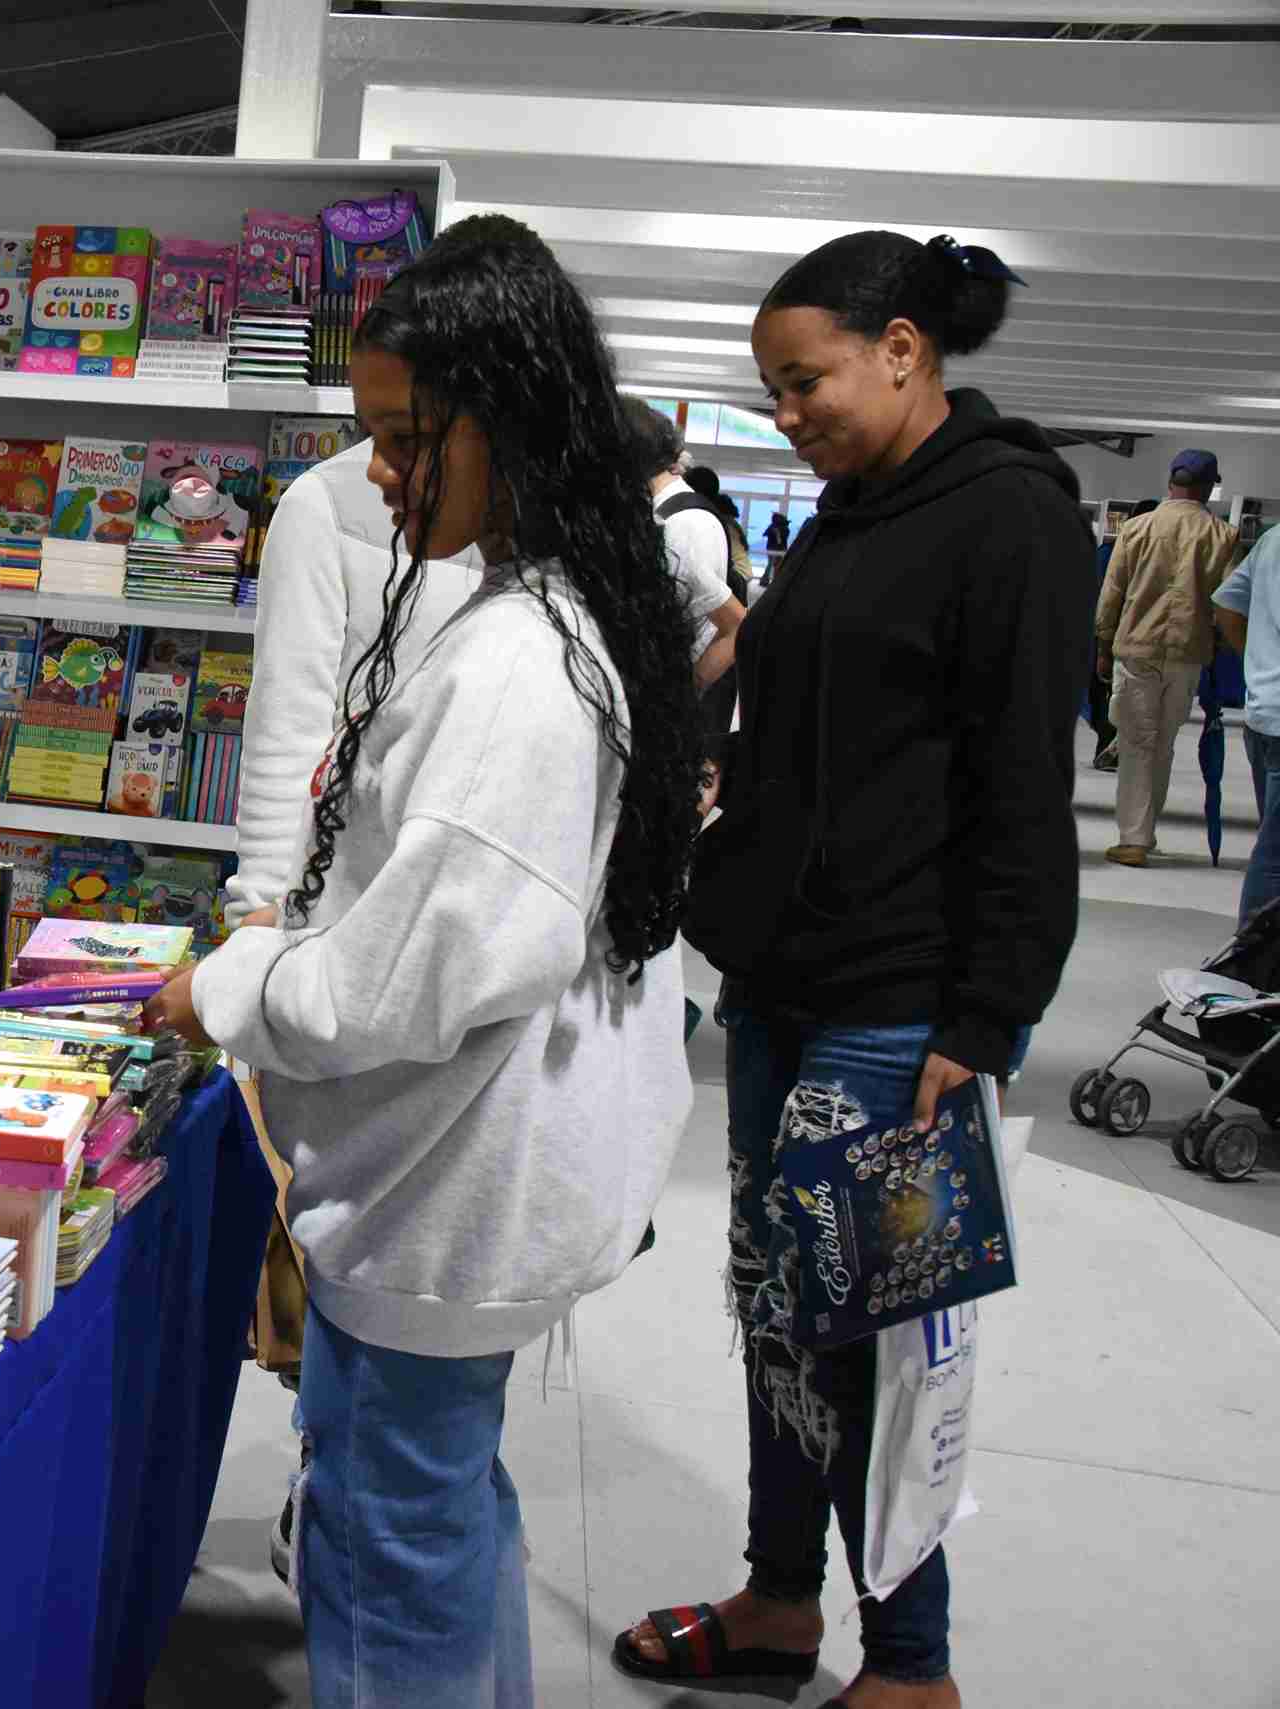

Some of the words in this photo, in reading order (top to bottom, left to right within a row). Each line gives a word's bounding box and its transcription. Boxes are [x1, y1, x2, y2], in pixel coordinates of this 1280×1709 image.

[53, 286, 84, 298] GRAN
[86, 286, 120, 298] LIBRO
[43, 301, 131, 321] COLORES
[68, 447, 120, 473] PRIMEROS
[198, 450, 248, 469] VACA
[813, 1180, 851, 1305] Escritor
